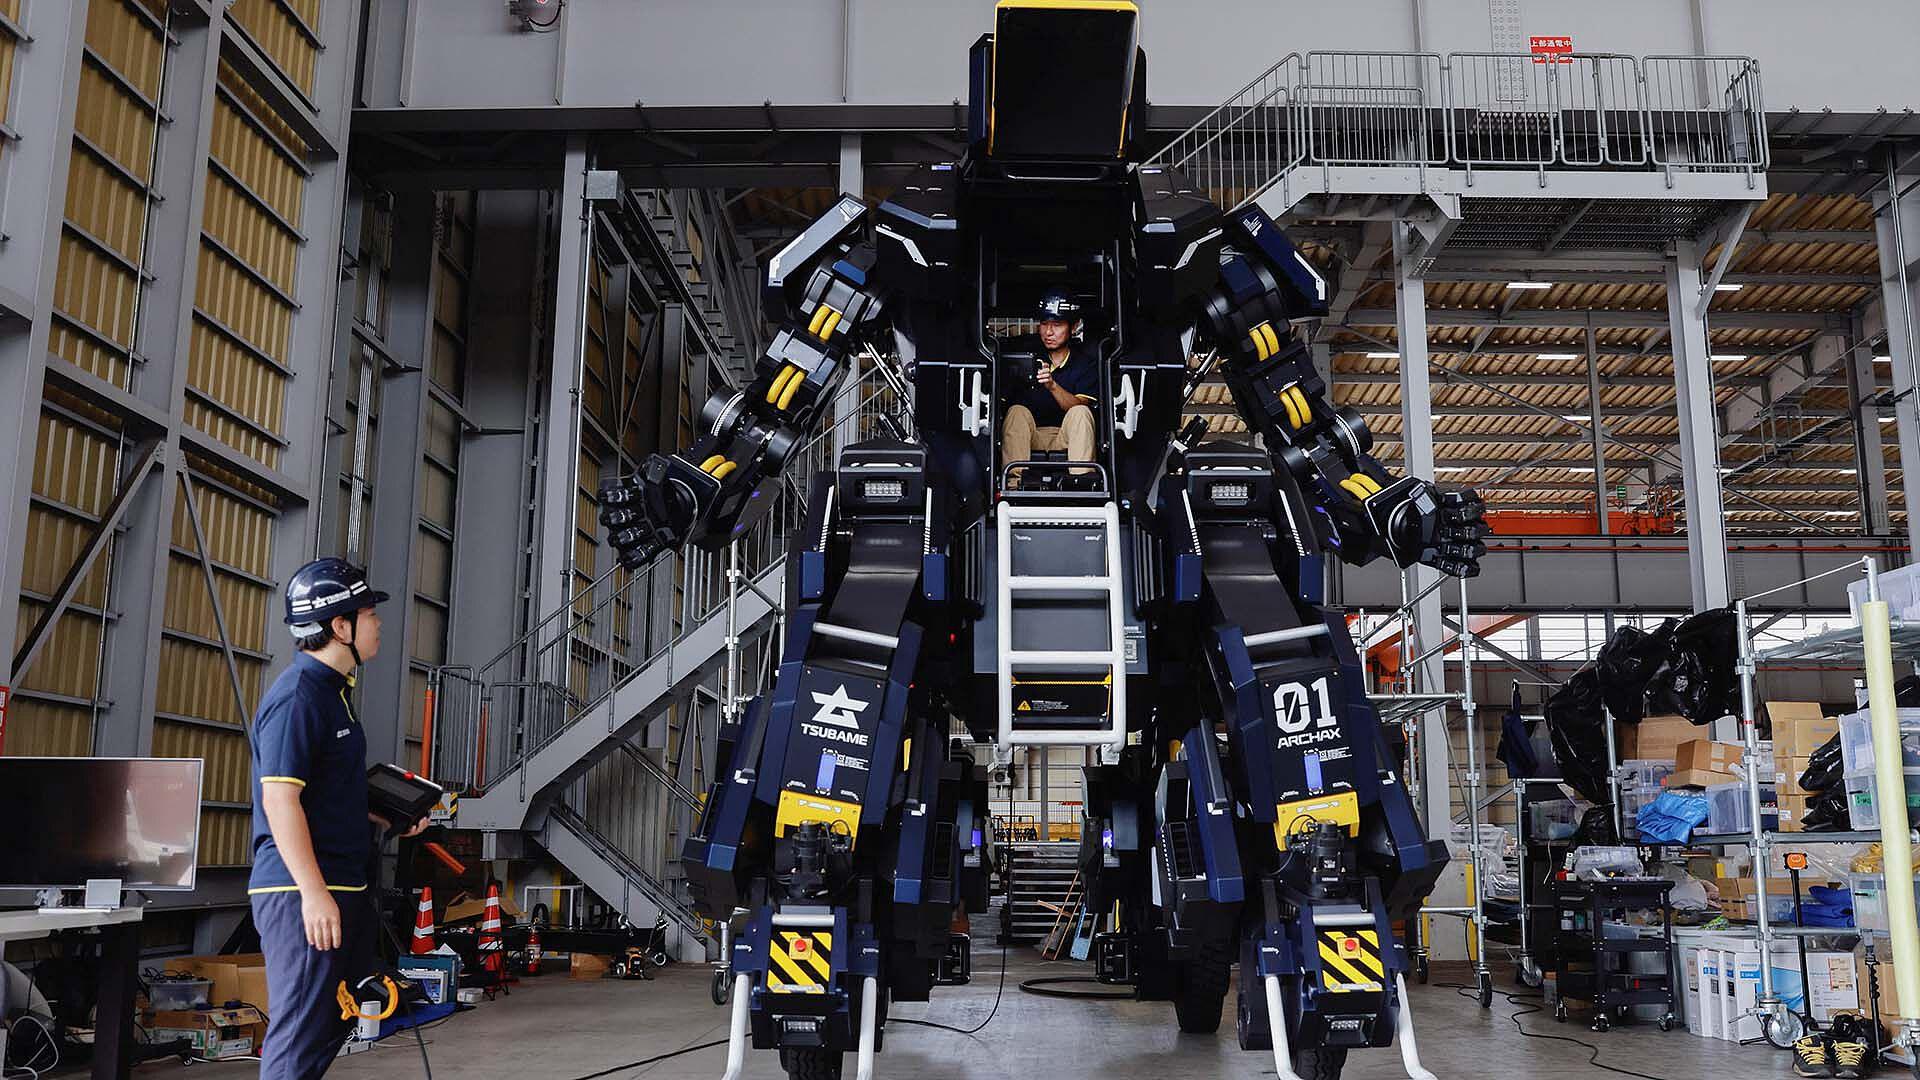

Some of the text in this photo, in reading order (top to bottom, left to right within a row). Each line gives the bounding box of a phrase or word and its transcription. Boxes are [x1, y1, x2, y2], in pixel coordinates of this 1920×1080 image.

[1273, 677, 1337, 734] 01
[801, 722, 869, 746] TSUBAME
[1277, 727, 1342, 749] ARCHAX
